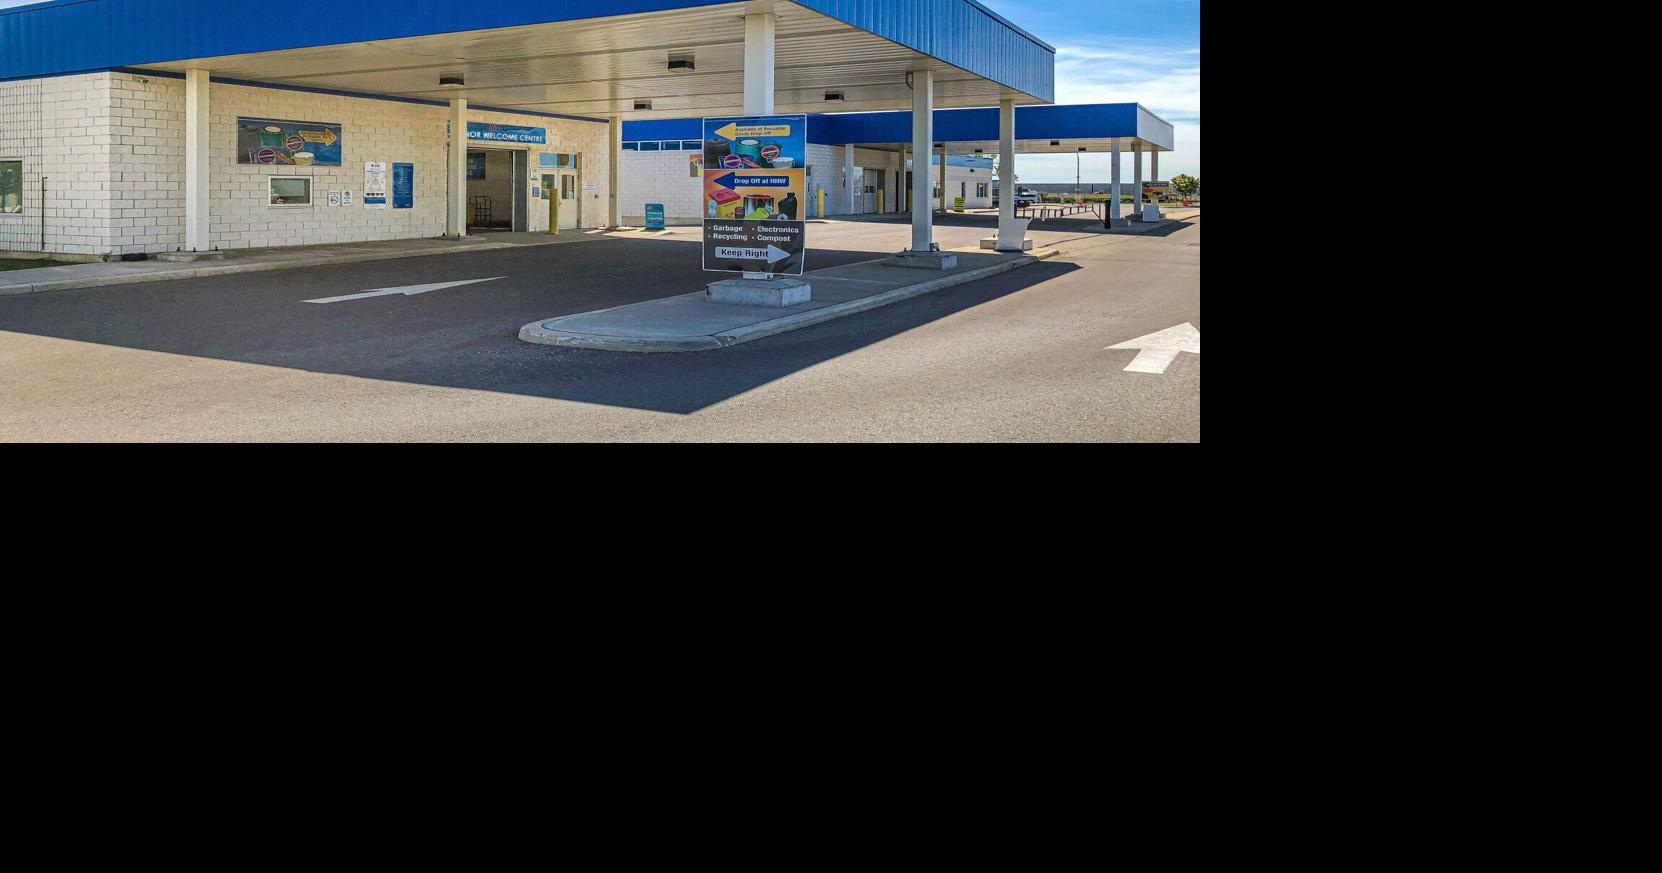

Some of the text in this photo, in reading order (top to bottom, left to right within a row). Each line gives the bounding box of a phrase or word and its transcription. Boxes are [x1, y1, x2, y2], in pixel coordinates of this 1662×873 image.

[482, 132, 518, 140] WELCOME
[520, 134, 542, 142] CENTRE
[757, 226, 800, 234] Electronics
[713, 233, 748, 241] Recycling
[721, 248, 768, 258] Keep Right
